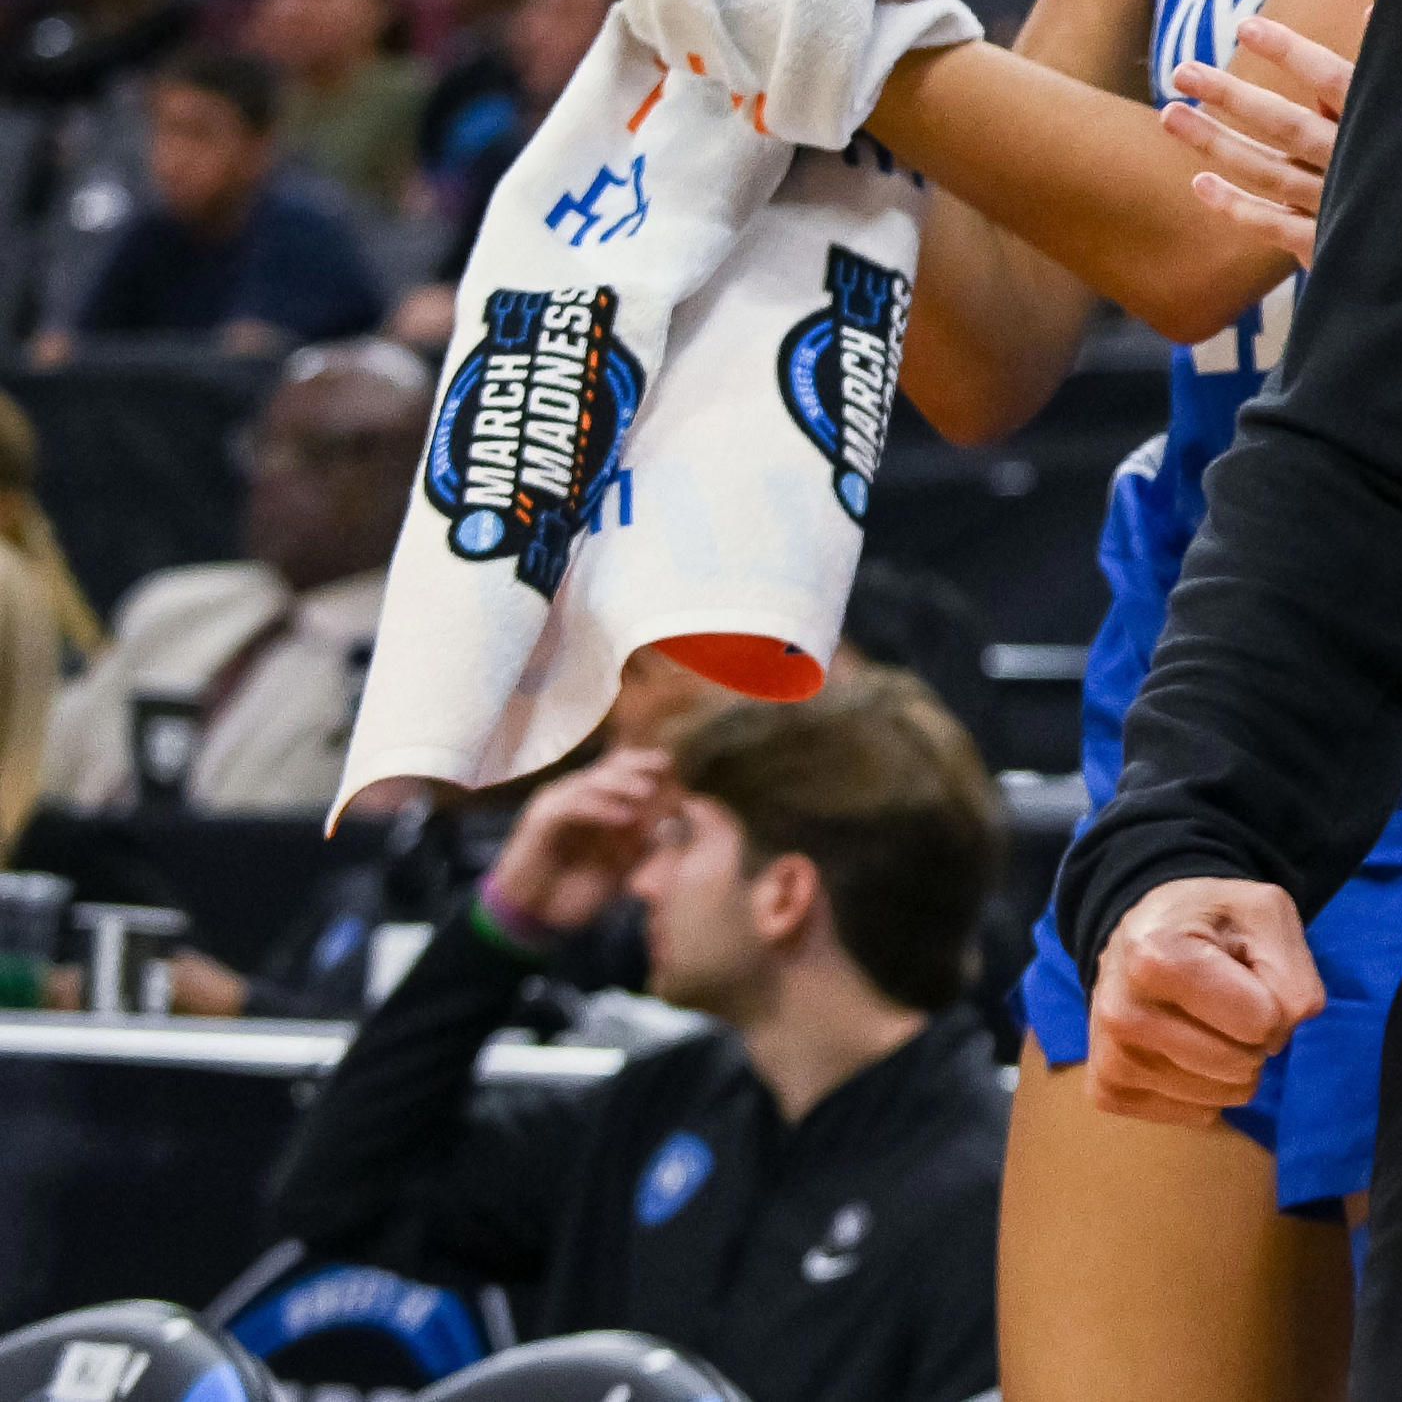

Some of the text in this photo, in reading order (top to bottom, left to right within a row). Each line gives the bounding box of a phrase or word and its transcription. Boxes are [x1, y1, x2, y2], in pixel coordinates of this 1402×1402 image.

[462, 353, 532, 509] MARCH
[519, 286, 598, 499] MADNESS
[839, 324, 887, 484] MARCH
